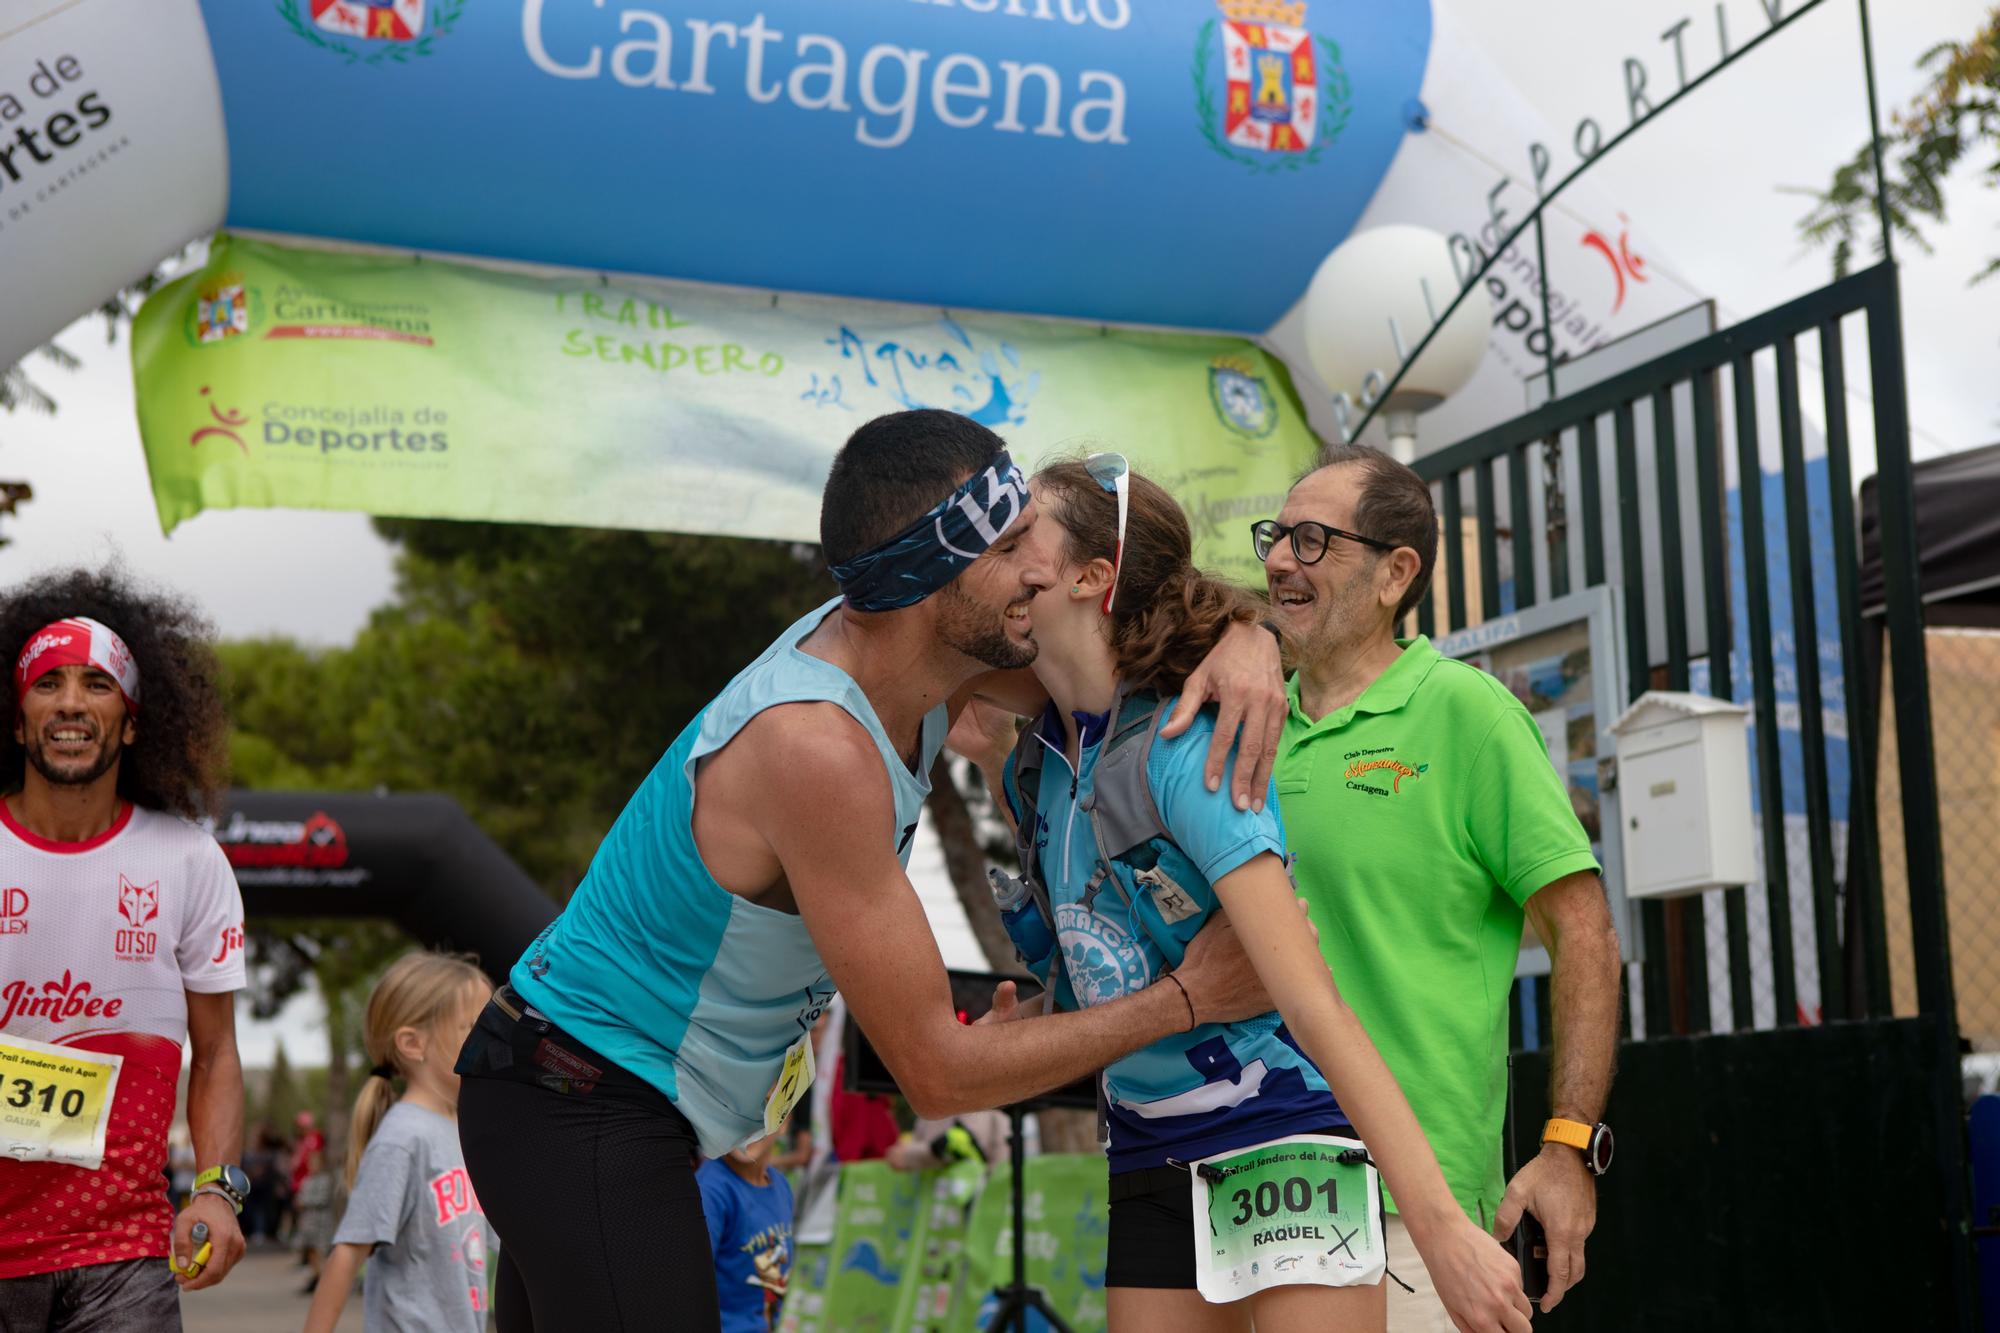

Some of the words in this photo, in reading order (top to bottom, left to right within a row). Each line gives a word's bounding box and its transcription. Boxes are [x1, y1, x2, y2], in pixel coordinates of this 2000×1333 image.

[30, 54, 83, 98] de
[522, 0, 1129, 148] Cartagena
[561, 328, 785, 377] SENDERO
[413, 406, 449, 425] de
[263, 421, 449, 454] Deportes
[1344, 749, 1361, 761] Club
[1361, 747, 1395, 757] Deportivo
[1346, 780, 1390, 797] Cartagena
[115, 929, 157, 955] OTSO
[0, 968, 123, 1030] Jimbee
[20, 1056, 57, 1070] Sendero
[59, 1064, 73, 1074] del
[76, 1068, 98, 1079] Agua
[4, 1114, 41, 1128] GALIFA
[1257, 1152, 1296, 1169] Sendero
[1299, 1151, 1317, 1161] del
[431, 1167, 484, 1227] RO
[1231, 1176, 1338, 1226] 3001
[1253, 1225, 1325, 1247] RAQUEL
